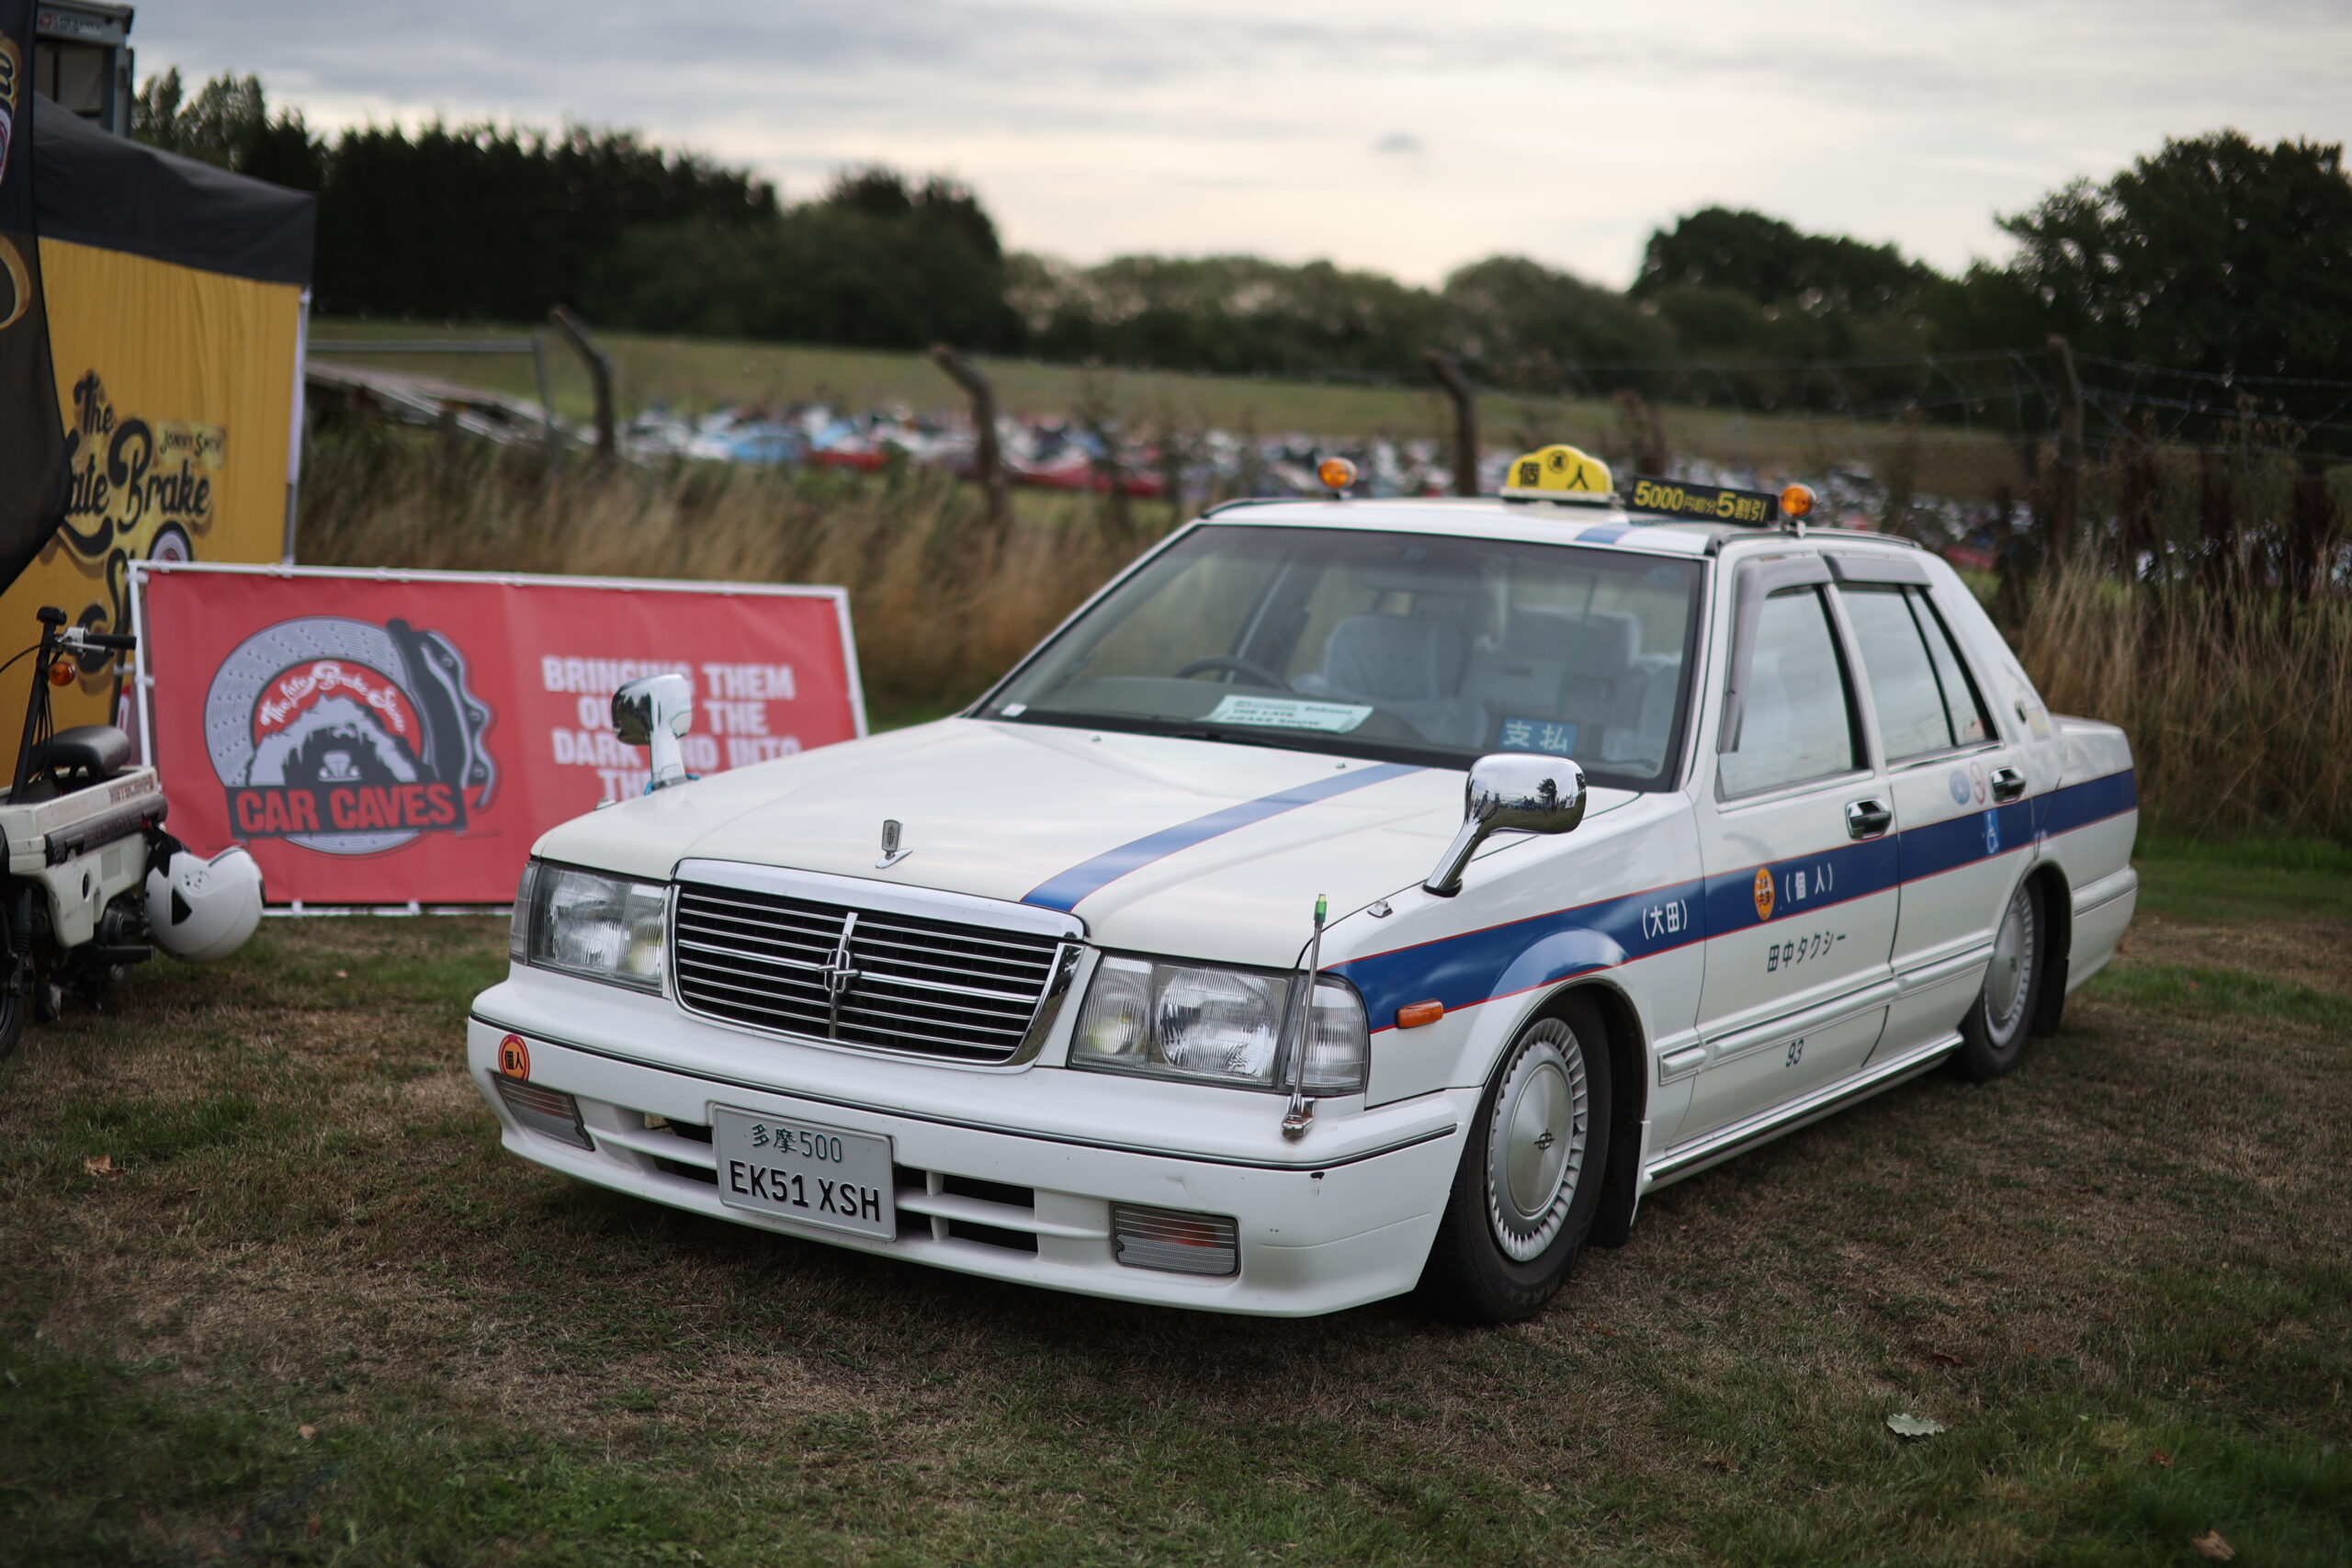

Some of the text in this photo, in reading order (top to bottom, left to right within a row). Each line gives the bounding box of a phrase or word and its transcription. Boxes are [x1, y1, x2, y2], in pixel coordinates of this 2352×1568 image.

[74, 372, 114, 435] The
[107, 418, 210, 534] Brake
[260, 698, 292, 726] The
[279, 675, 317, 708] Late
[312, 660, 368, 696] Brake
[702, 663, 797, 700] THEM
[703, 701, 769, 736] THE
[1504, 720, 1568, 752] 支払
[552, 729, 642, 768] DARK
[236, 784, 456, 832] CAR CAVES
[1767, 930, 1846, 973] 田中タクシー
[504, 1051, 524, 1070] 個人
[1786, 1039, 1804, 1067] 93
[729, 1159, 880, 1222] EK51 XSH
